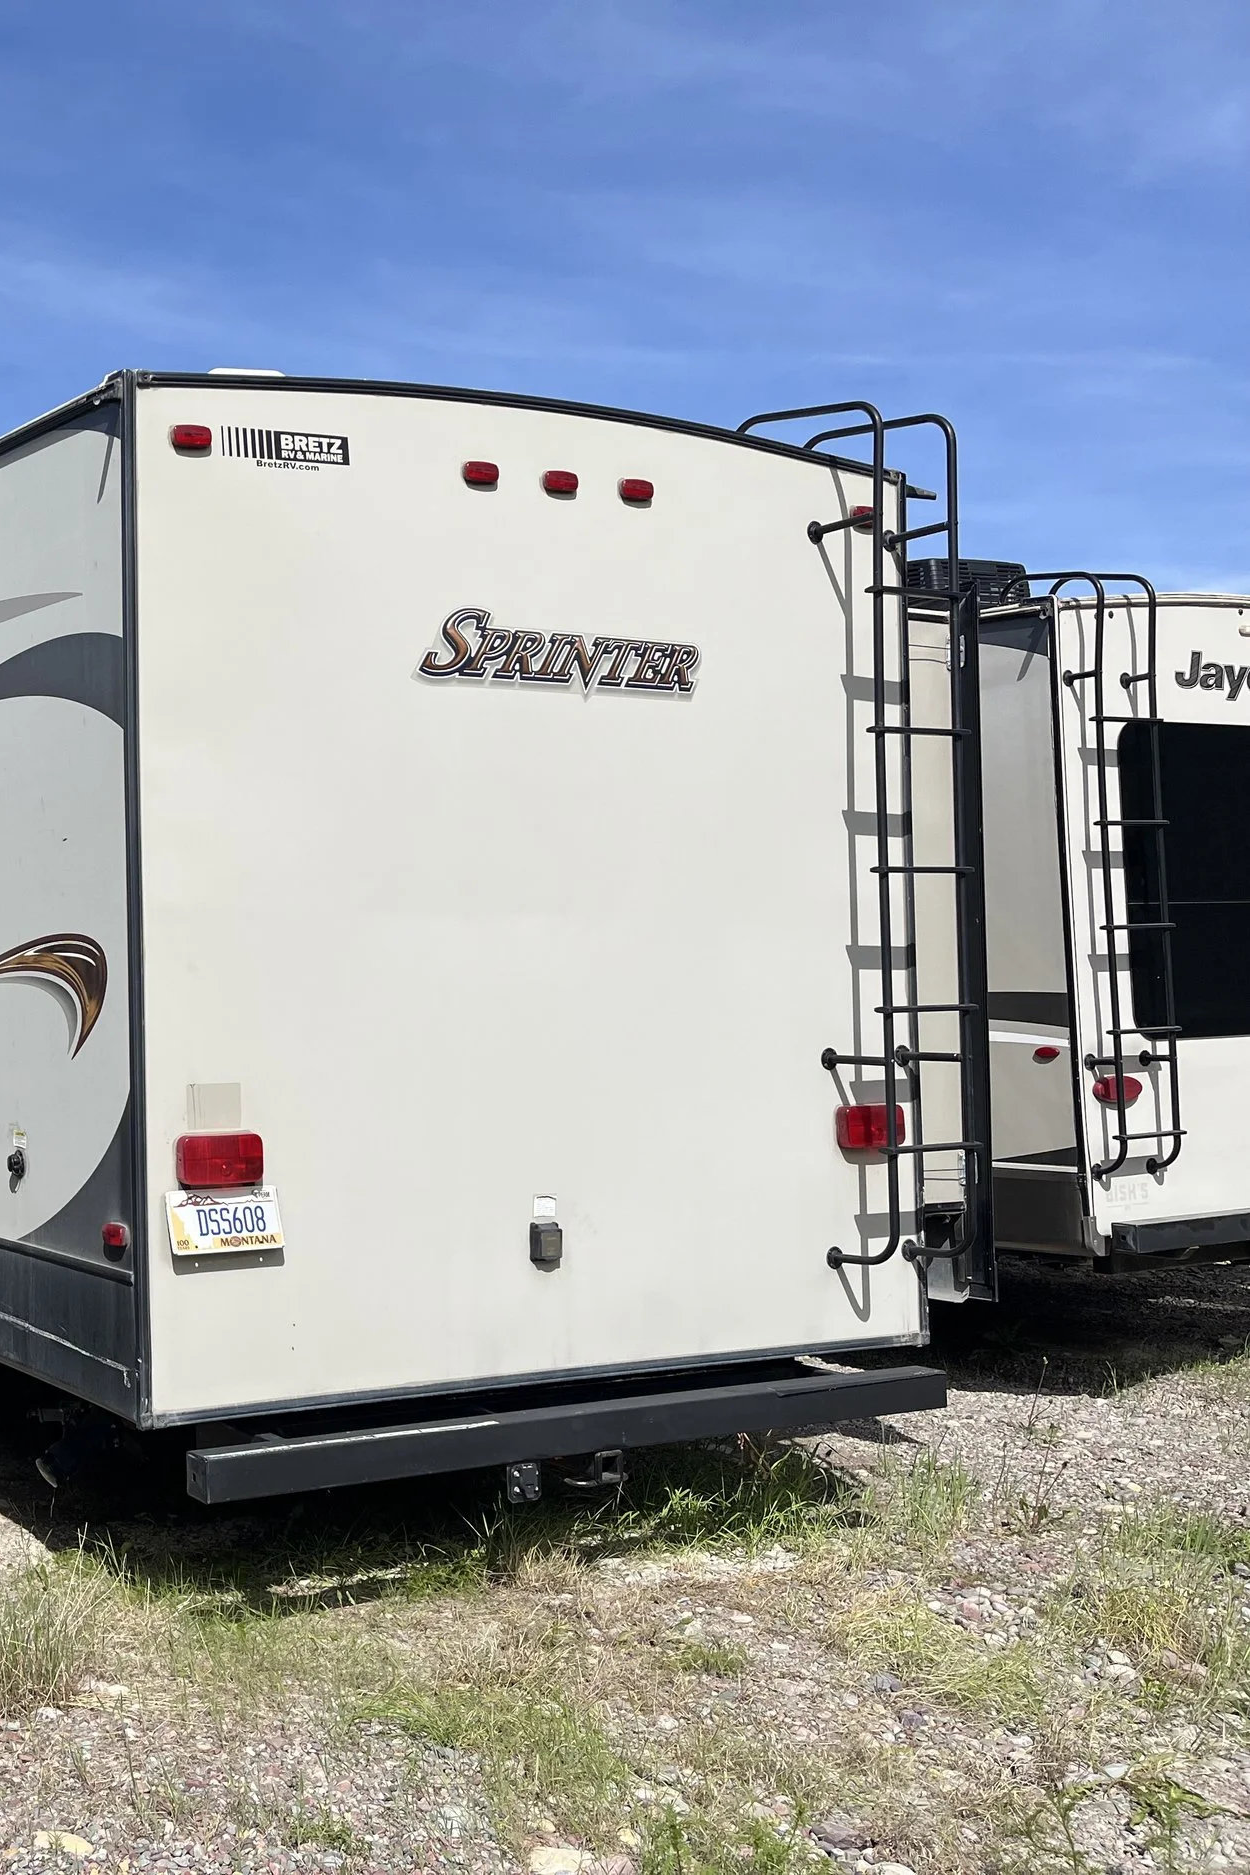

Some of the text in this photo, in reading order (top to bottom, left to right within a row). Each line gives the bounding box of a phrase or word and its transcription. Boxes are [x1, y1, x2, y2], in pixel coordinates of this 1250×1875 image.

[280, 434, 343, 454] BRETZ
[256, 460, 320, 471] BretzRV.com
[281, 450, 295, 459] RV
[306, 452, 343, 463] MARINE
[418, 606, 699, 694] SPRINTER
[1174, 650, 1250, 701] Jay
[196, 1205, 266, 1236] DSS608
[220, 1234, 277, 1247] MONTANA
